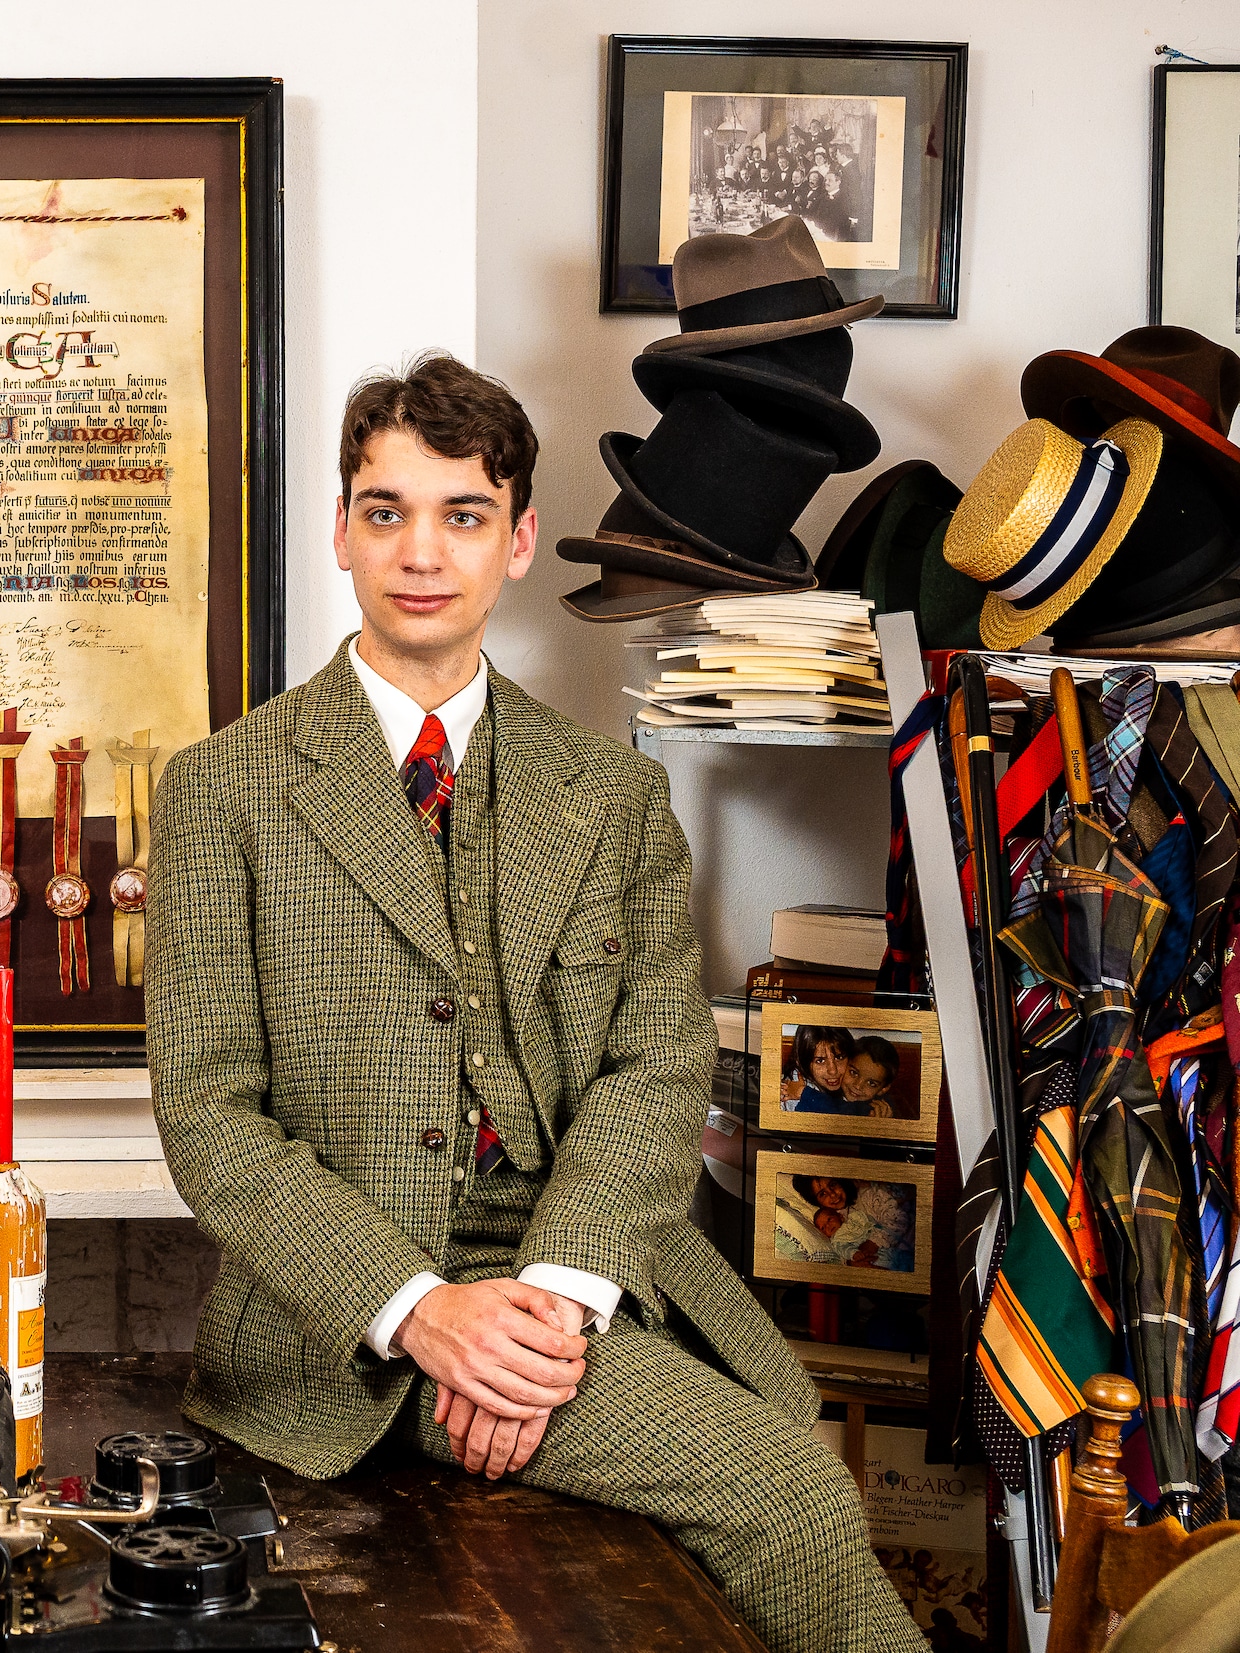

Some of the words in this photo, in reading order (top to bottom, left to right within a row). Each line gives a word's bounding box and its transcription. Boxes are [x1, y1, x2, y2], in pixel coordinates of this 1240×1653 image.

[1071, 749, 1081, 781] Barbour
[863, 1459, 881, 1467] zart
[897, 1495, 932, 1508] Heather
[933, 1498, 966, 1511] Harper
[868, 1525, 900, 1536] enboim
